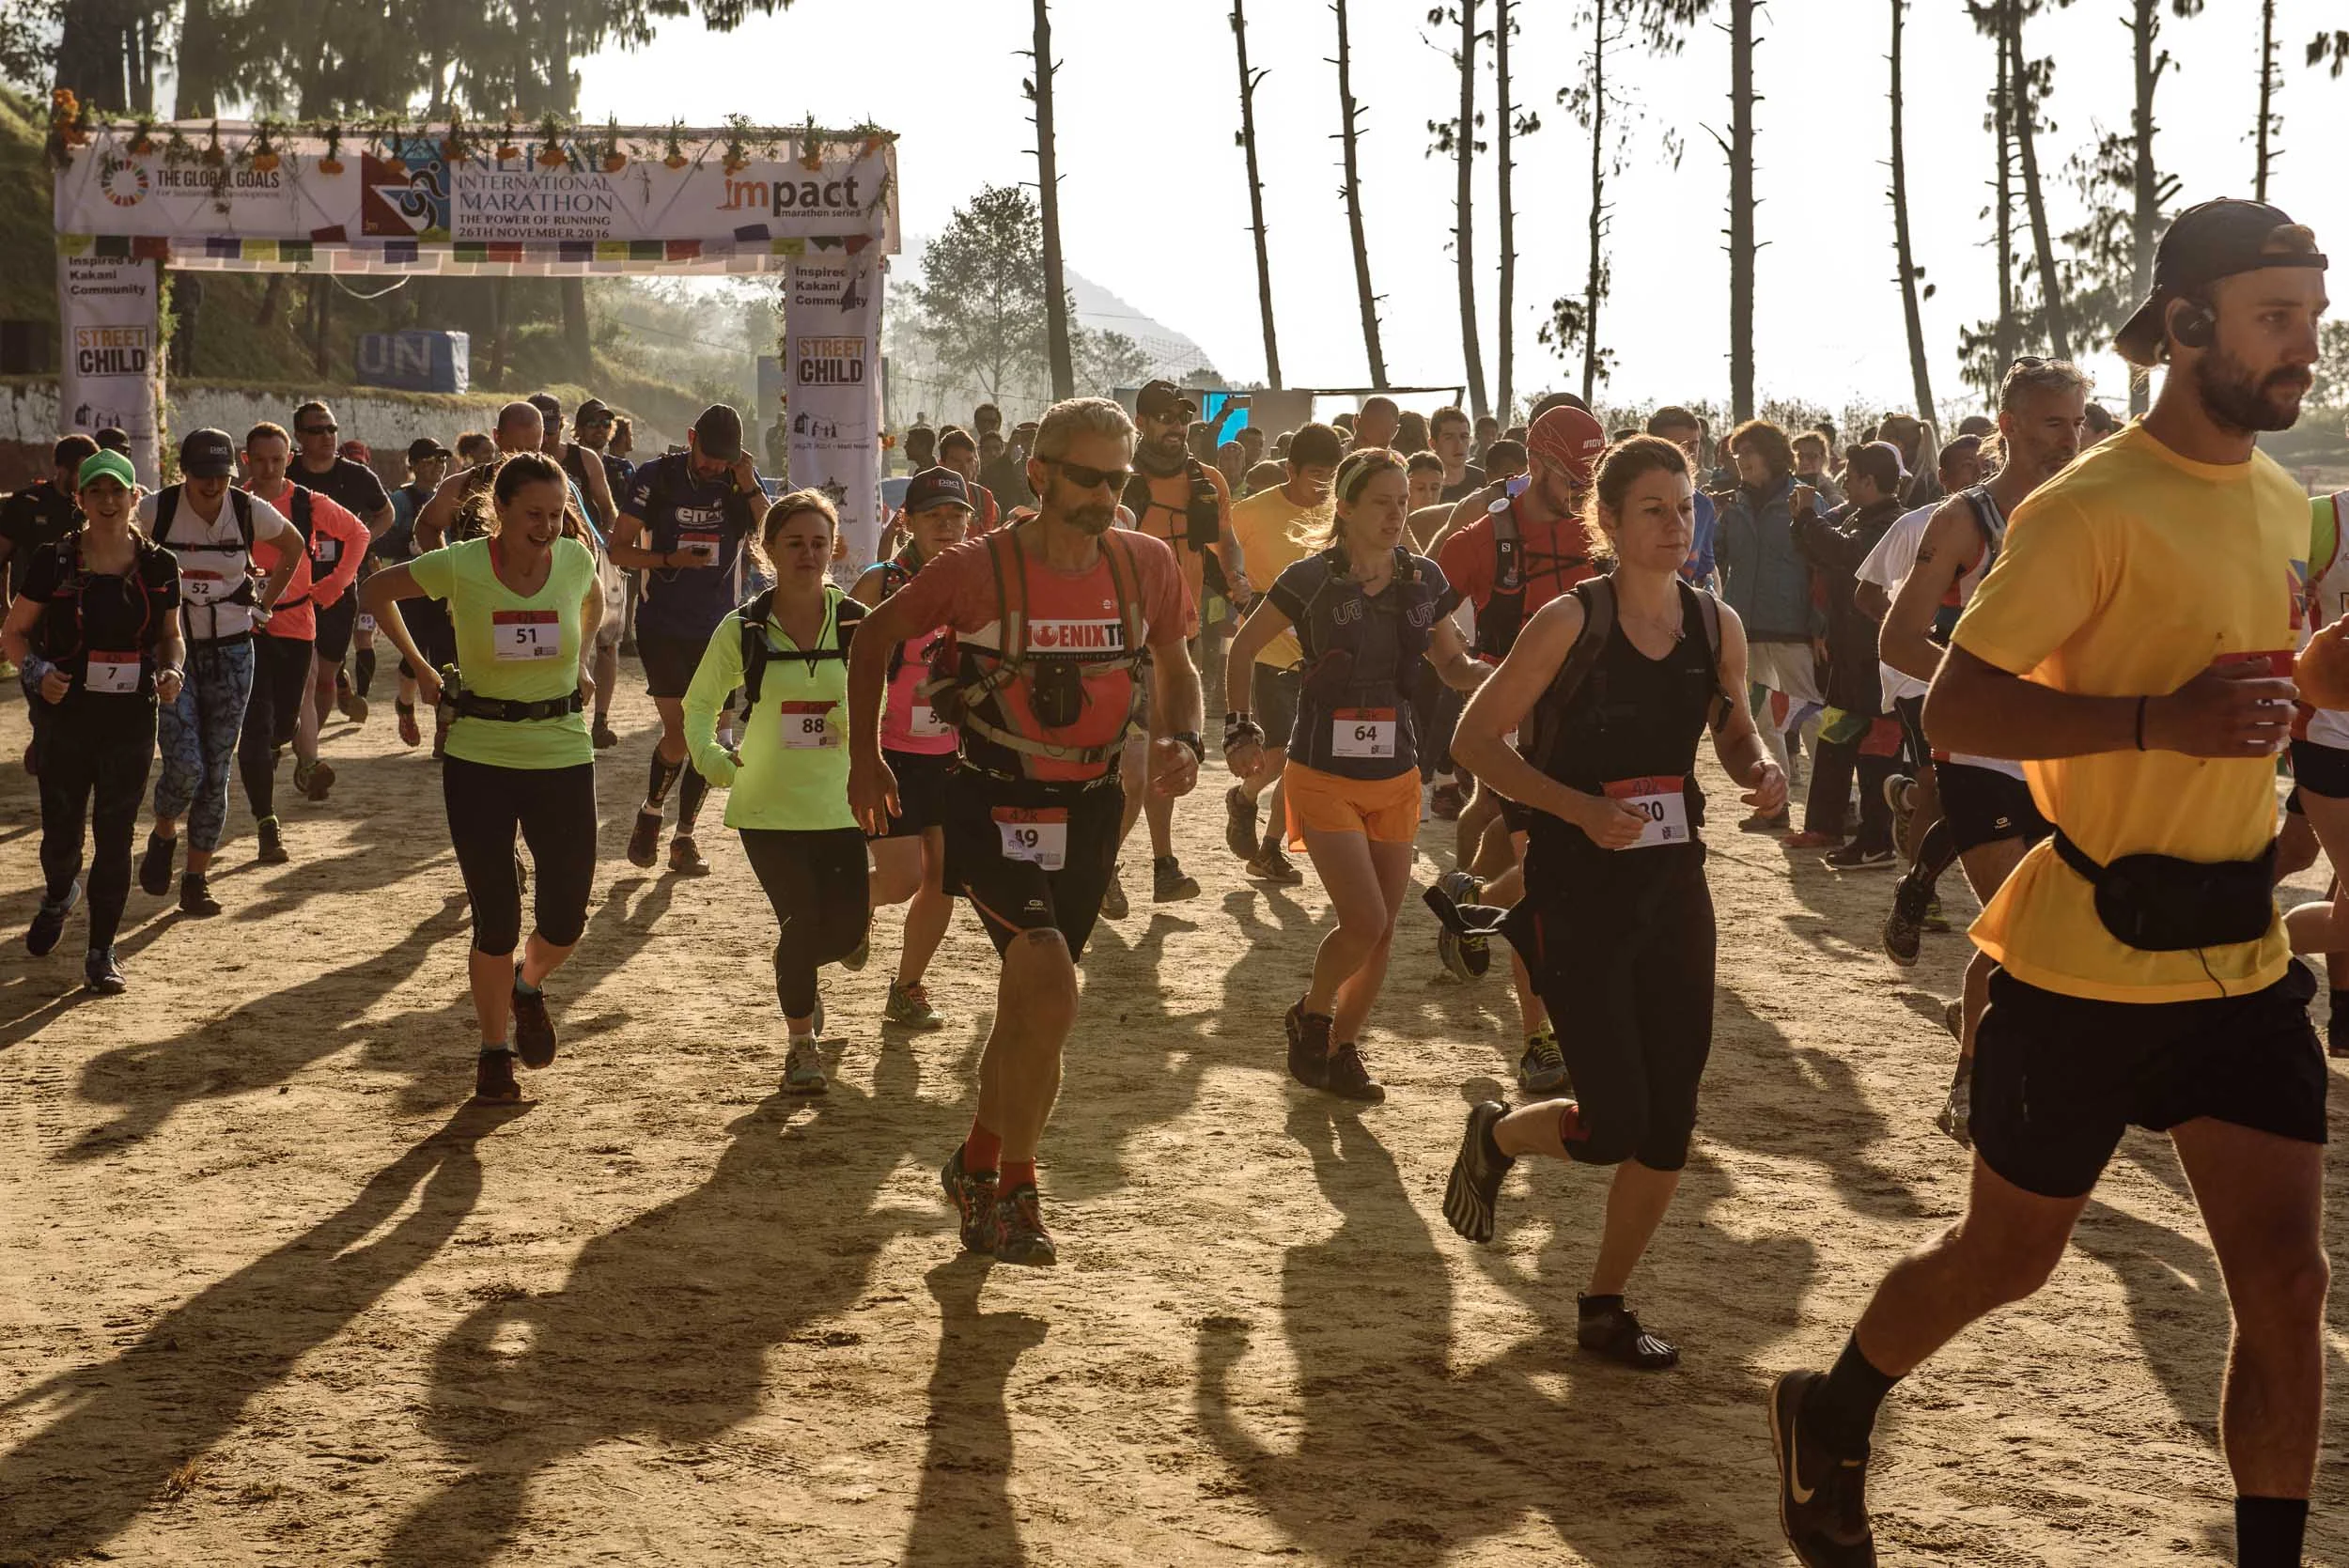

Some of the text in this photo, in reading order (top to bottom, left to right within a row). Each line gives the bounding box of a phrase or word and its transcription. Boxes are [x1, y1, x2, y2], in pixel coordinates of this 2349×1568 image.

[157, 170, 279, 188] THE GLOBAL GOALS
[459, 176, 613, 191] INTERNATIONAL
[459, 193, 613, 212] MARATHON
[716, 176, 859, 217] impact
[459, 214, 611, 225] THE POWER OF RUNNING
[782, 209, 862, 217] marathon series
[459, 227, 610, 239] 26TH NOVEMBER 2016
[69, 256, 124, 267] Inspired
[70, 270, 117, 280] Kakani
[70, 284, 147, 297] Community
[795, 281, 841, 291] Kakani
[795, 295, 868, 307] Commuty
[78, 330, 144, 347] STREET
[359, 333, 431, 376] UN
[800, 339, 864, 357] STREET
[79, 349, 147, 373] CHILD
[800, 359, 863, 382] CHILD
[192, 583, 210, 594] 52
[517, 629, 537, 644] 51
[108, 667, 117, 679] 7
[803, 719, 824, 733] 88
[1355, 726, 1377, 740] 64
[1015, 829, 1038, 847] 49
